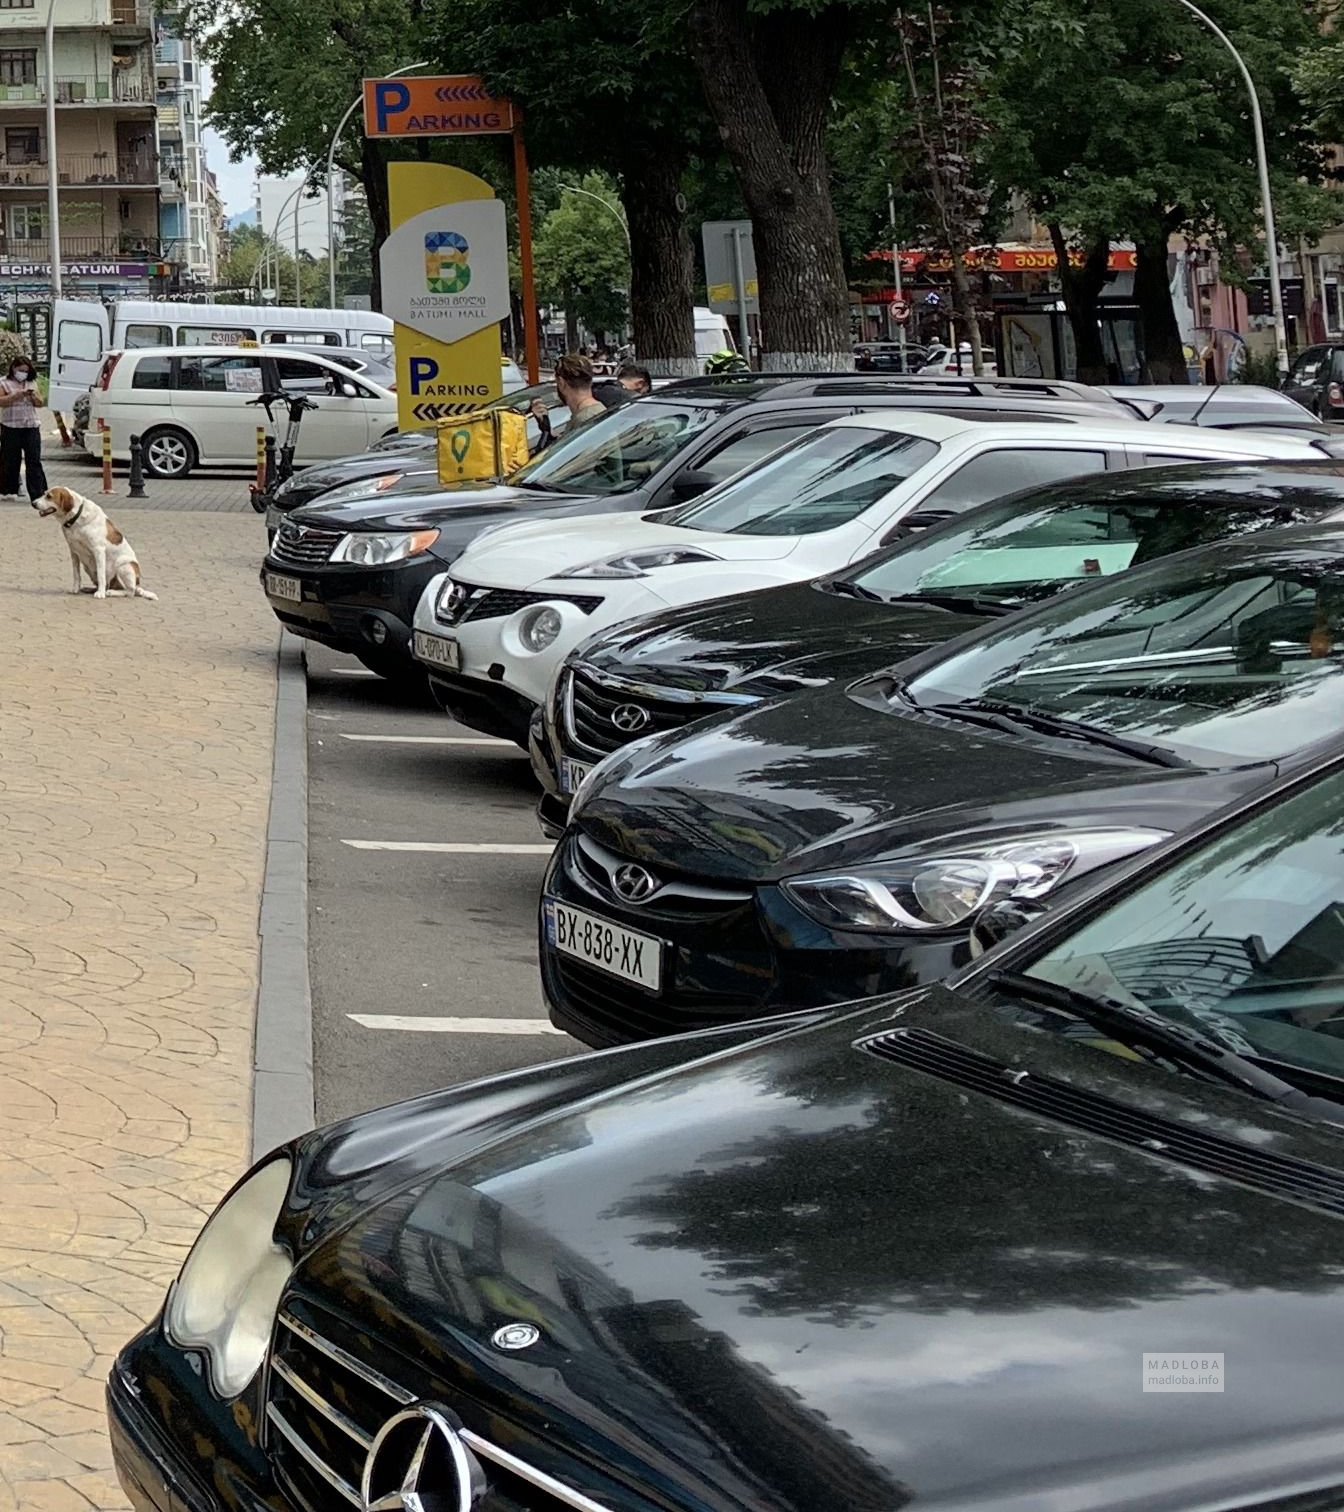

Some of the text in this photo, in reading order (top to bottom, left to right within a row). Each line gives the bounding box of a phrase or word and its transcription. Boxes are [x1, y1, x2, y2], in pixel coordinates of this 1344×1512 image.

[375, 83, 500, 132] PARKING
[410, 309, 487, 319] BATUMI MALL
[409, 356, 490, 396] PARKING
[557, 908, 643, 978] BX-838-XX
